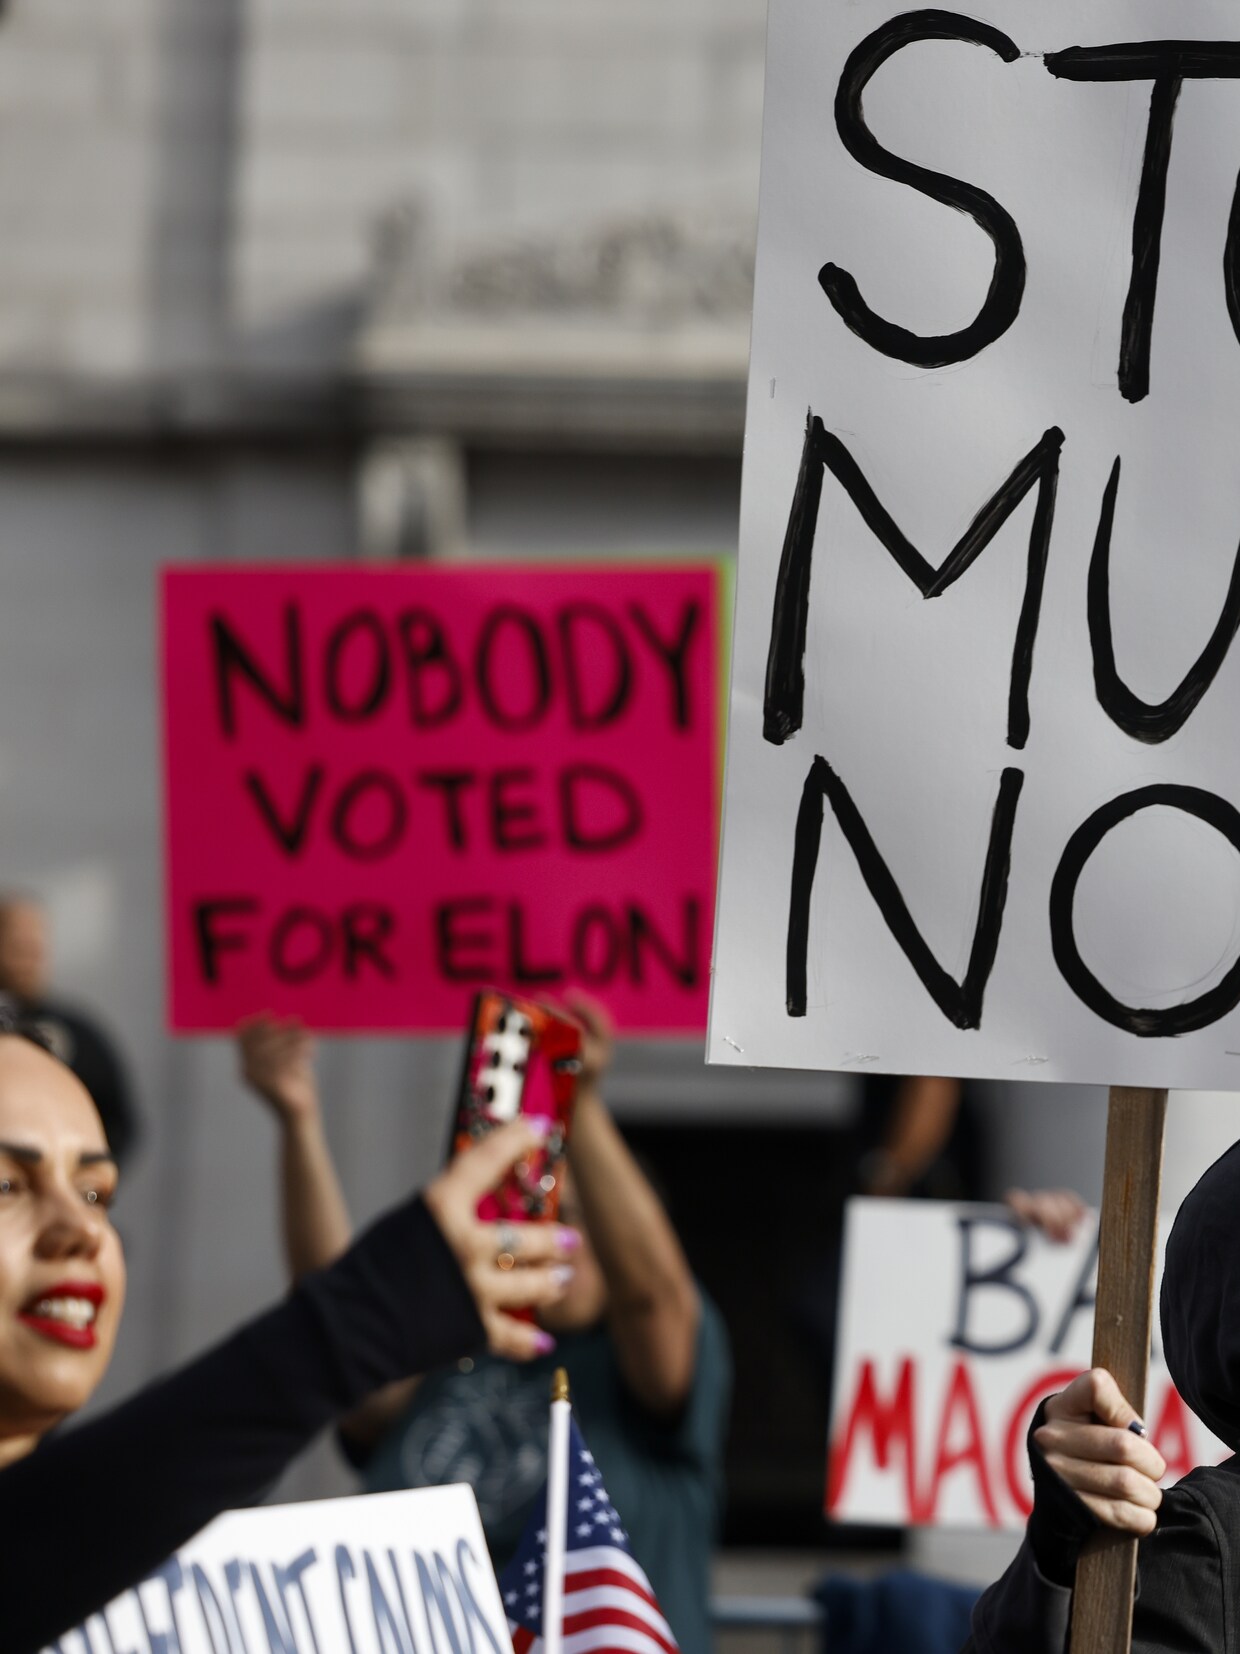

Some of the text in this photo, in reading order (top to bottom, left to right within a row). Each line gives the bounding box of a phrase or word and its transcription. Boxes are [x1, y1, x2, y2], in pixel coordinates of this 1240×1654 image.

[207, 597, 704, 740] NOBODY
[244, 760, 644, 861] VOTED
[191, 893, 699, 989] FOR ELON
